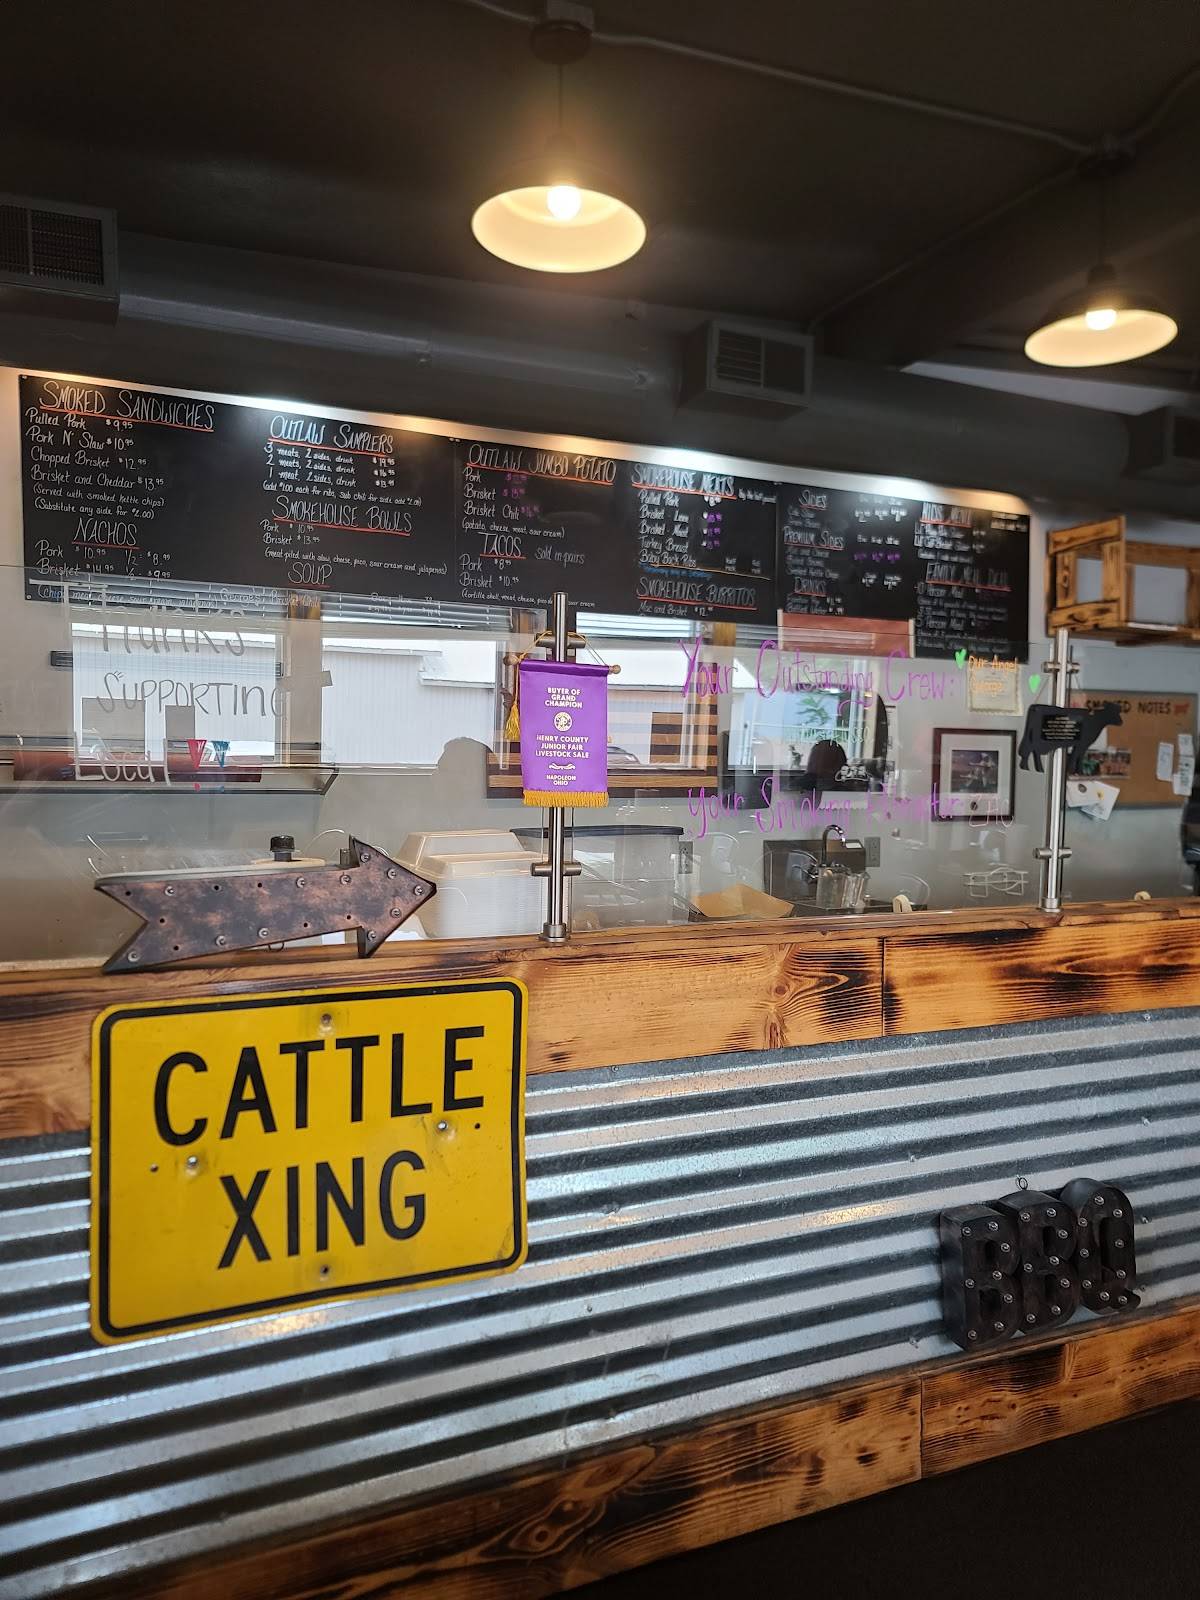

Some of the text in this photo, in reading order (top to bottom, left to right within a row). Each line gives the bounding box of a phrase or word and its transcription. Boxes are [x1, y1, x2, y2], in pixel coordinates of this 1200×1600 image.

[40, 381, 216, 430] SMOKED SANDWICHES
[26, 408, 133, 432] Pulled Pork $9.95
[26, 426, 54, 446] Pork
[80, 432, 105, 450] Slaw
[107, 439, 134, 451] $10.95
[271, 416, 394, 454] OUTLAW SAMPLERS
[32, 447, 71, 469] Chopped
[76, 451, 110, 469] Brisket
[264, 443, 274, 454] 3
[306, 449, 312, 458] 2
[336, 456, 354, 465] drink
[267, 454, 275, 466] 2
[306, 460, 313, 469] 2
[336, 466, 356, 475] drink
[469, 444, 617, 484] OUTLAW JUMBO POTATO
[32, 465, 70, 483] Brisket
[76, 475, 92, 486] and
[98, 474, 135, 489] Cheddar
[307, 472, 313, 482] 2
[337, 477, 356, 488] drink
[463, 466, 481, 484] Pork
[68, 490, 83, 500] with
[88, 493, 115, 503] smoked
[296, 486, 310, 495] each
[312, 486, 322, 495] for
[464, 483, 496, 501] Brisket
[799, 490, 827, 508] SIDES
[81, 506, 94, 517] any
[96, 507, 112, 515] side
[117, 506, 128, 516] for
[272, 495, 413, 533] SMOKEHOUSE BOWLS
[464, 500, 496, 518] Brisket
[503, 504, 520, 521] Chili
[74, 517, 138, 547] NACHOS
[260, 519, 280, 533] Pork
[263, 533, 293, 545] Brisket
[478, 532, 522, 558] TACOS
[36, 540, 64, 558] Pork
[37, 558, 81, 577] Brisket
[303, 553, 316, 561] with
[369, 560, 383, 568] sour
[384, 562, 403, 570] cream
[405, 564, 417, 572] and
[459, 554, 483, 573] Pork
[288, 562, 333, 585] SOUP
[459, 572, 494, 589] Brisket
[636, 577, 757, 607] SMOKEHOUSE BURRITOS
[679, 636, 738, 698] Your
[547, 687, 581, 696] BUYER OF
[551, 694, 576, 702] GRAND
[545, 700, 583, 709] CHAMPION
[1137, 702, 1171, 715] NOTES
[536, 734, 589, 744] HENRY COUNTY
[540, 743, 567, 751] JUNIOR
[535, 750, 589, 759] LIVESTOCK SALE
[153, 1025, 486, 1146] CATTLE
[217, 1149, 426, 1269] XING
